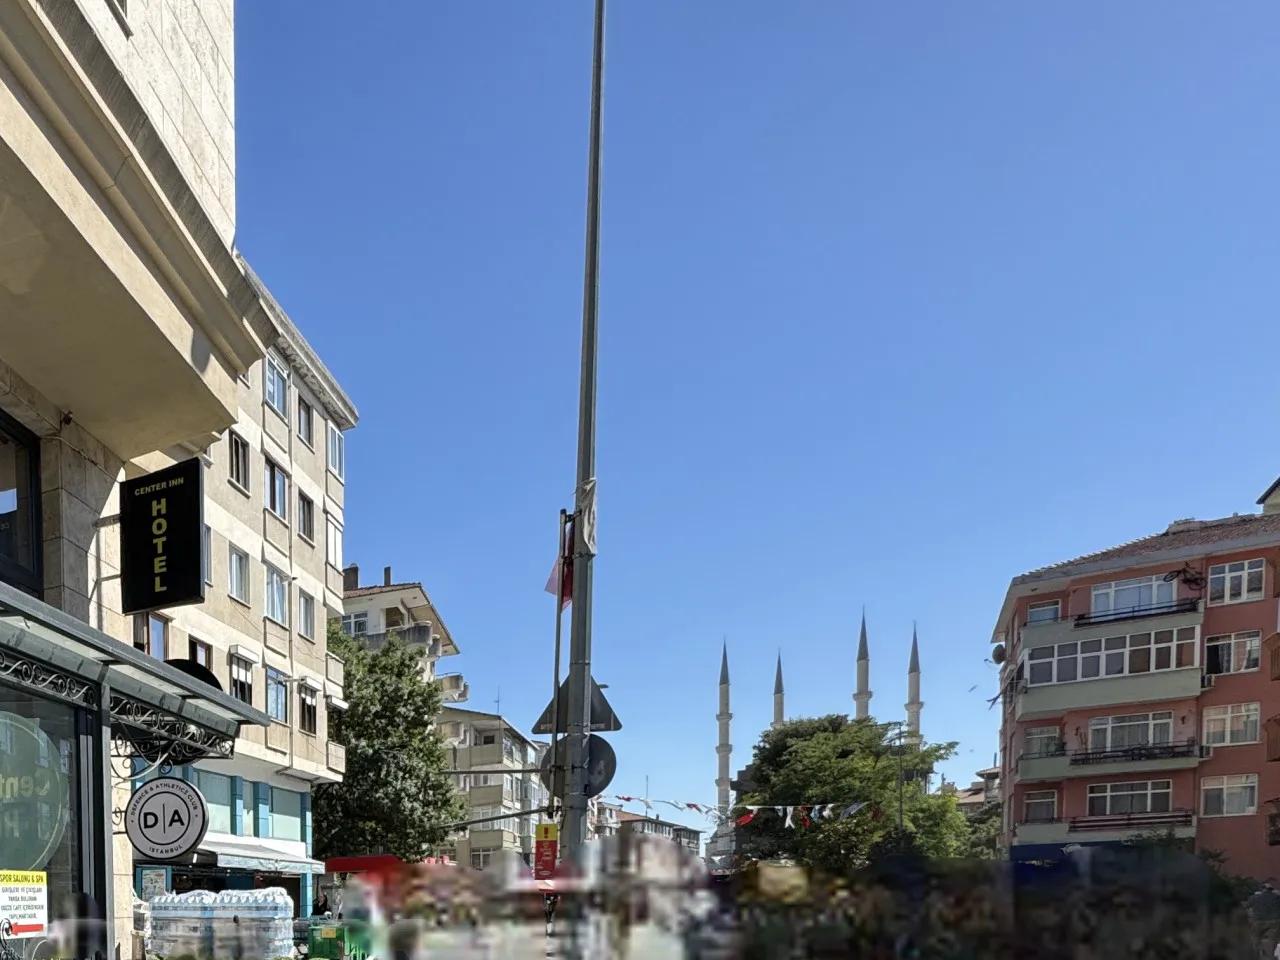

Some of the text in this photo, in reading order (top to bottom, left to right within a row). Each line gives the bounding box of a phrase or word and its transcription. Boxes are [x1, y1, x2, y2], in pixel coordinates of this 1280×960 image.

[134, 477, 184, 496] CENTER INN
[151, 498, 168, 593] HOTEL
[130, 789, 149, 816] DEFENCE
[155, 783, 189, 795] ATHLETICS
[187, 795, 198, 810] CLUB
[0, 874, 12, 883] SPOR
[12, 874, 30, 883] SALONU
[35, 875, 44, 883] SPA
